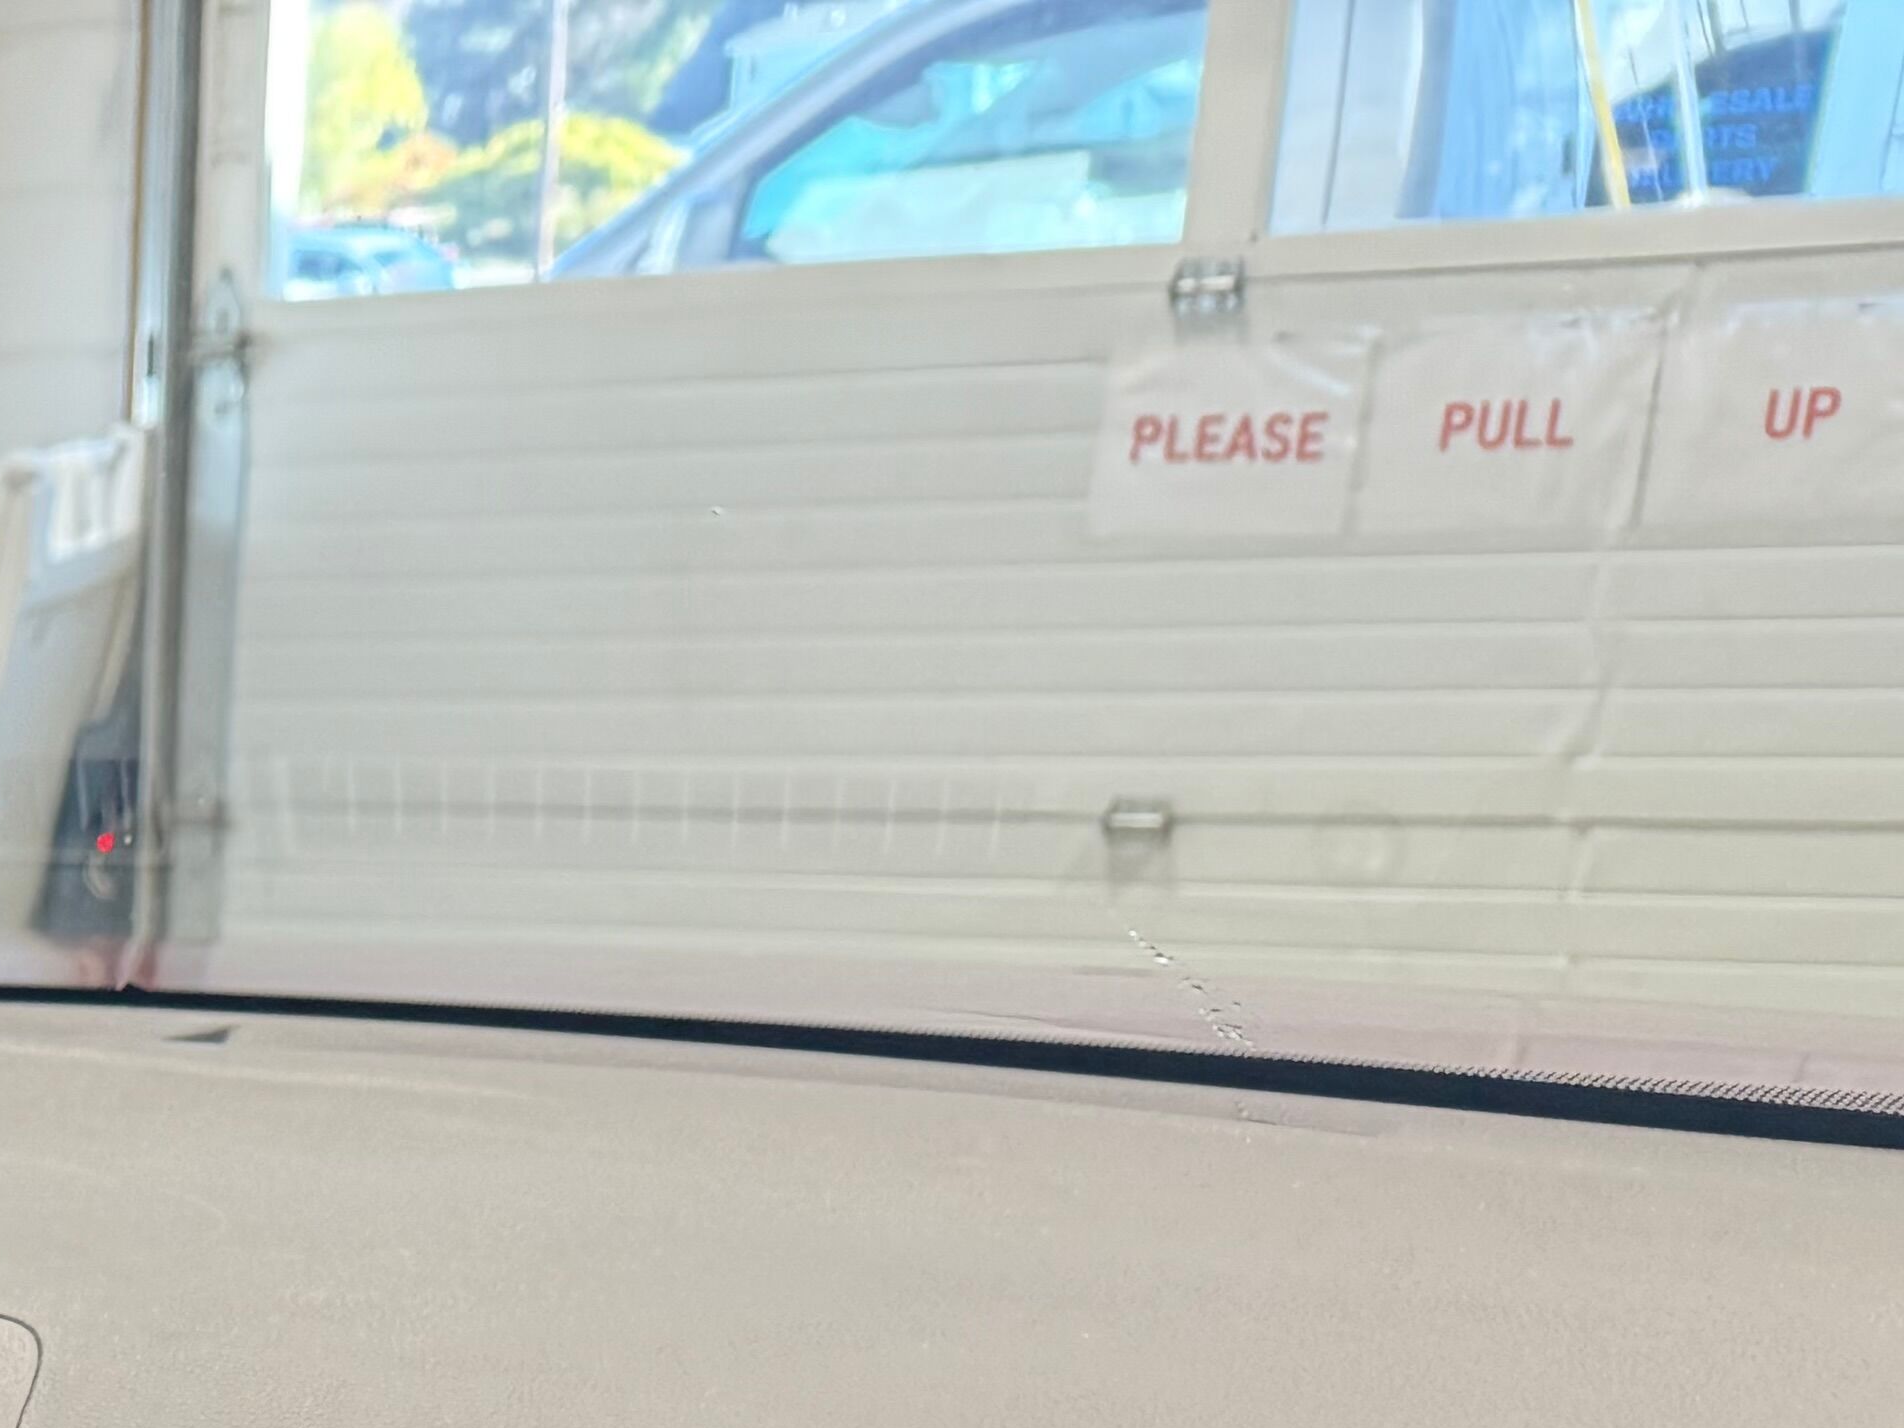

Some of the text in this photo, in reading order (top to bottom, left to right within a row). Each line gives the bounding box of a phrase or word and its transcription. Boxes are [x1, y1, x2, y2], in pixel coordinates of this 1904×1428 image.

[1128, 387, 1842, 465] PLEASE PULL UP
